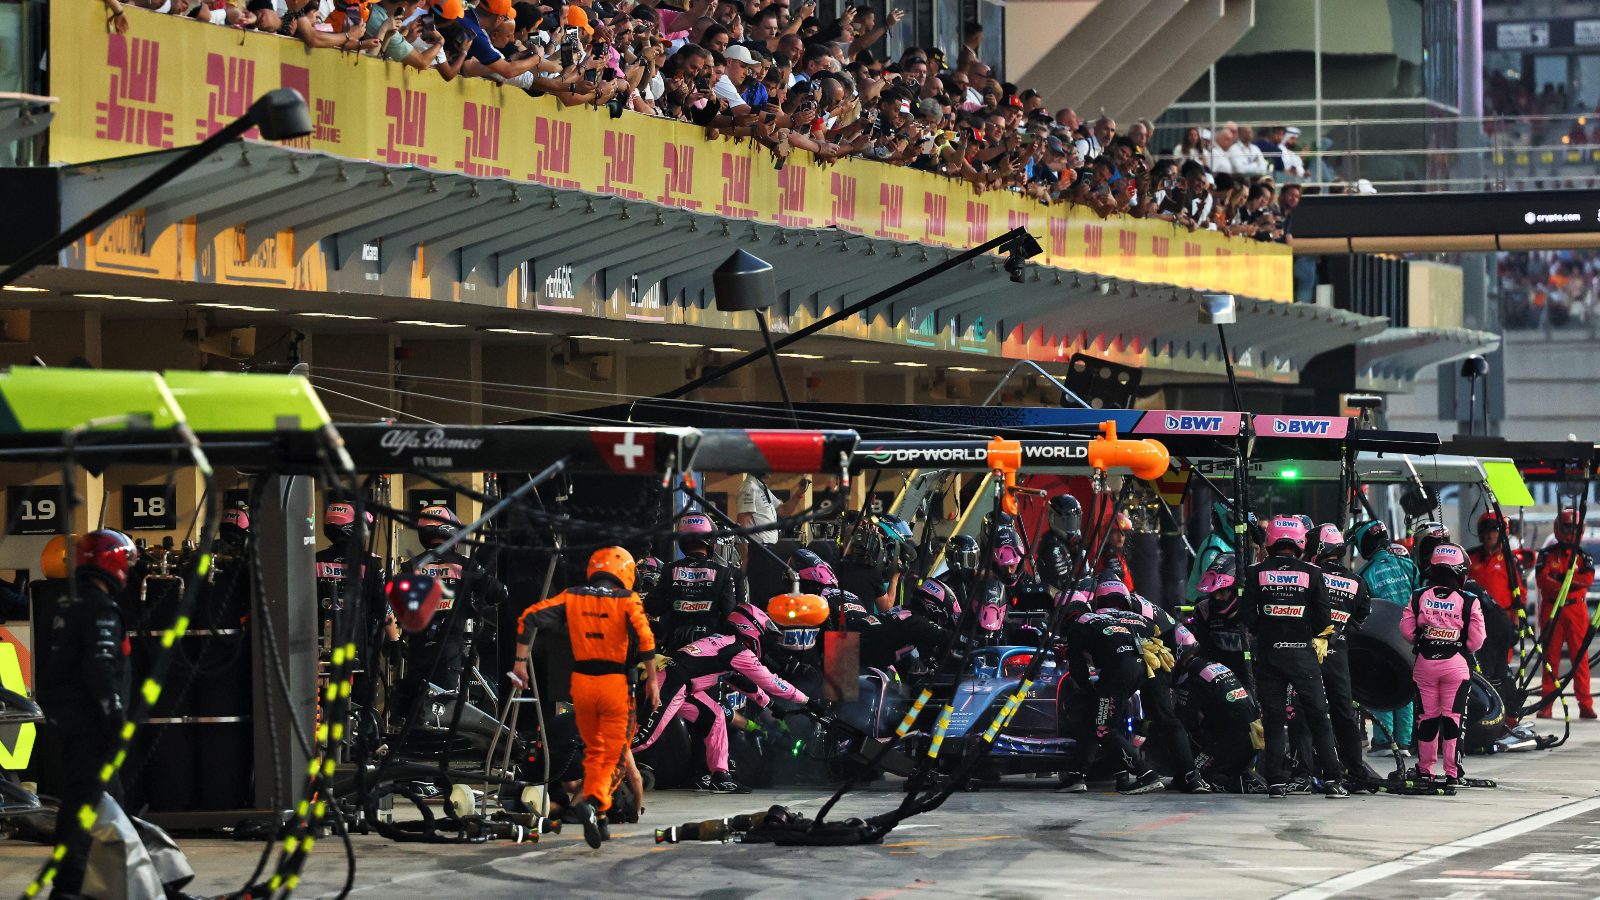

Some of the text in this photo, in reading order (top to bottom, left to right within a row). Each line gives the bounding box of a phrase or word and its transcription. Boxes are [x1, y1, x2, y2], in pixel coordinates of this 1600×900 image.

[1180, 416, 1222, 431] BWT
[1288, 420, 1330, 434] BWT
[380, 428, 485, 456] Alfa Romeo
[896, 448, 988, 461] DP WORLD
[1025, 445, 1088, 459] WORLD
[426, 457, 452, 467] TEAM
[21, 499, 56, 521] 19
[133, 496, 166, 517] 18
[1282, 521, 1298, 529] BWT
[429, 567, 450, 577] BWT
[688, 571, 708, 580] BWT
[1276, 575, 1299, 584] BWT
[1330, 578, 1351, 590] BWT
[926, 582, 941, 594] BWT
[1261, 585, 1305, 593] ALPINE
[1328, 588, 1356, 600] PINE
[681, 601, 710, 611] Castrol
[1272, 605, 1303, 616] Castrol
[1433, 600, 1455, 611] BWT
[1330, 612, 1348, 622] strol
[1420, 609, 1460, 620] ALPINE
[1428, 628, 1457, 639] Castrol
